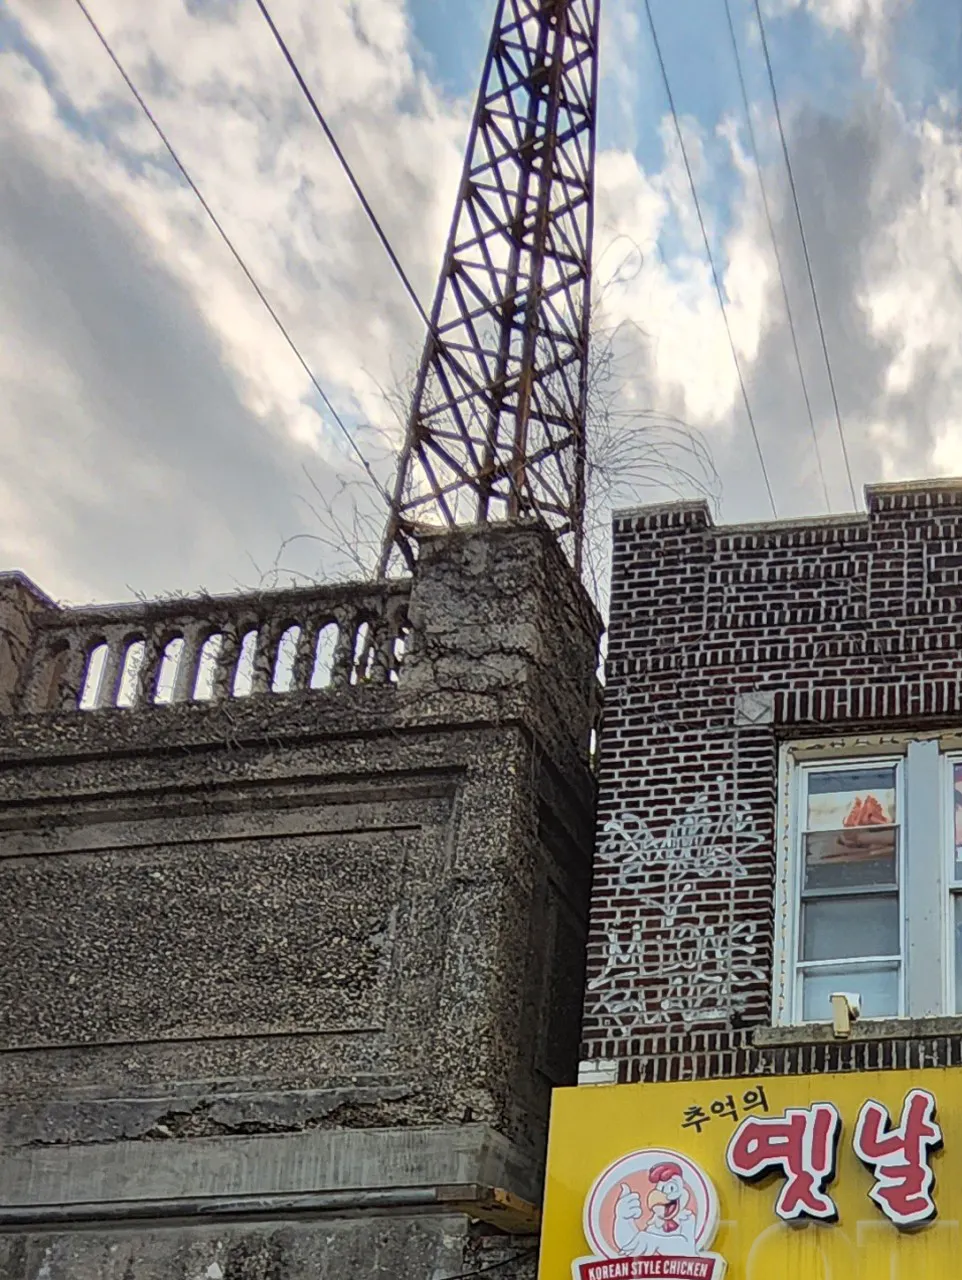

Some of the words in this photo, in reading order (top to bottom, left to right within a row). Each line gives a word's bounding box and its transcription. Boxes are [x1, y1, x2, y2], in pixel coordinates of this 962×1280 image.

[680, 1085, 769, 1133] 추억의
[630, 1260, 661, 1276] STYLE
[663, 1260, 709, 1278] CHICKEN
